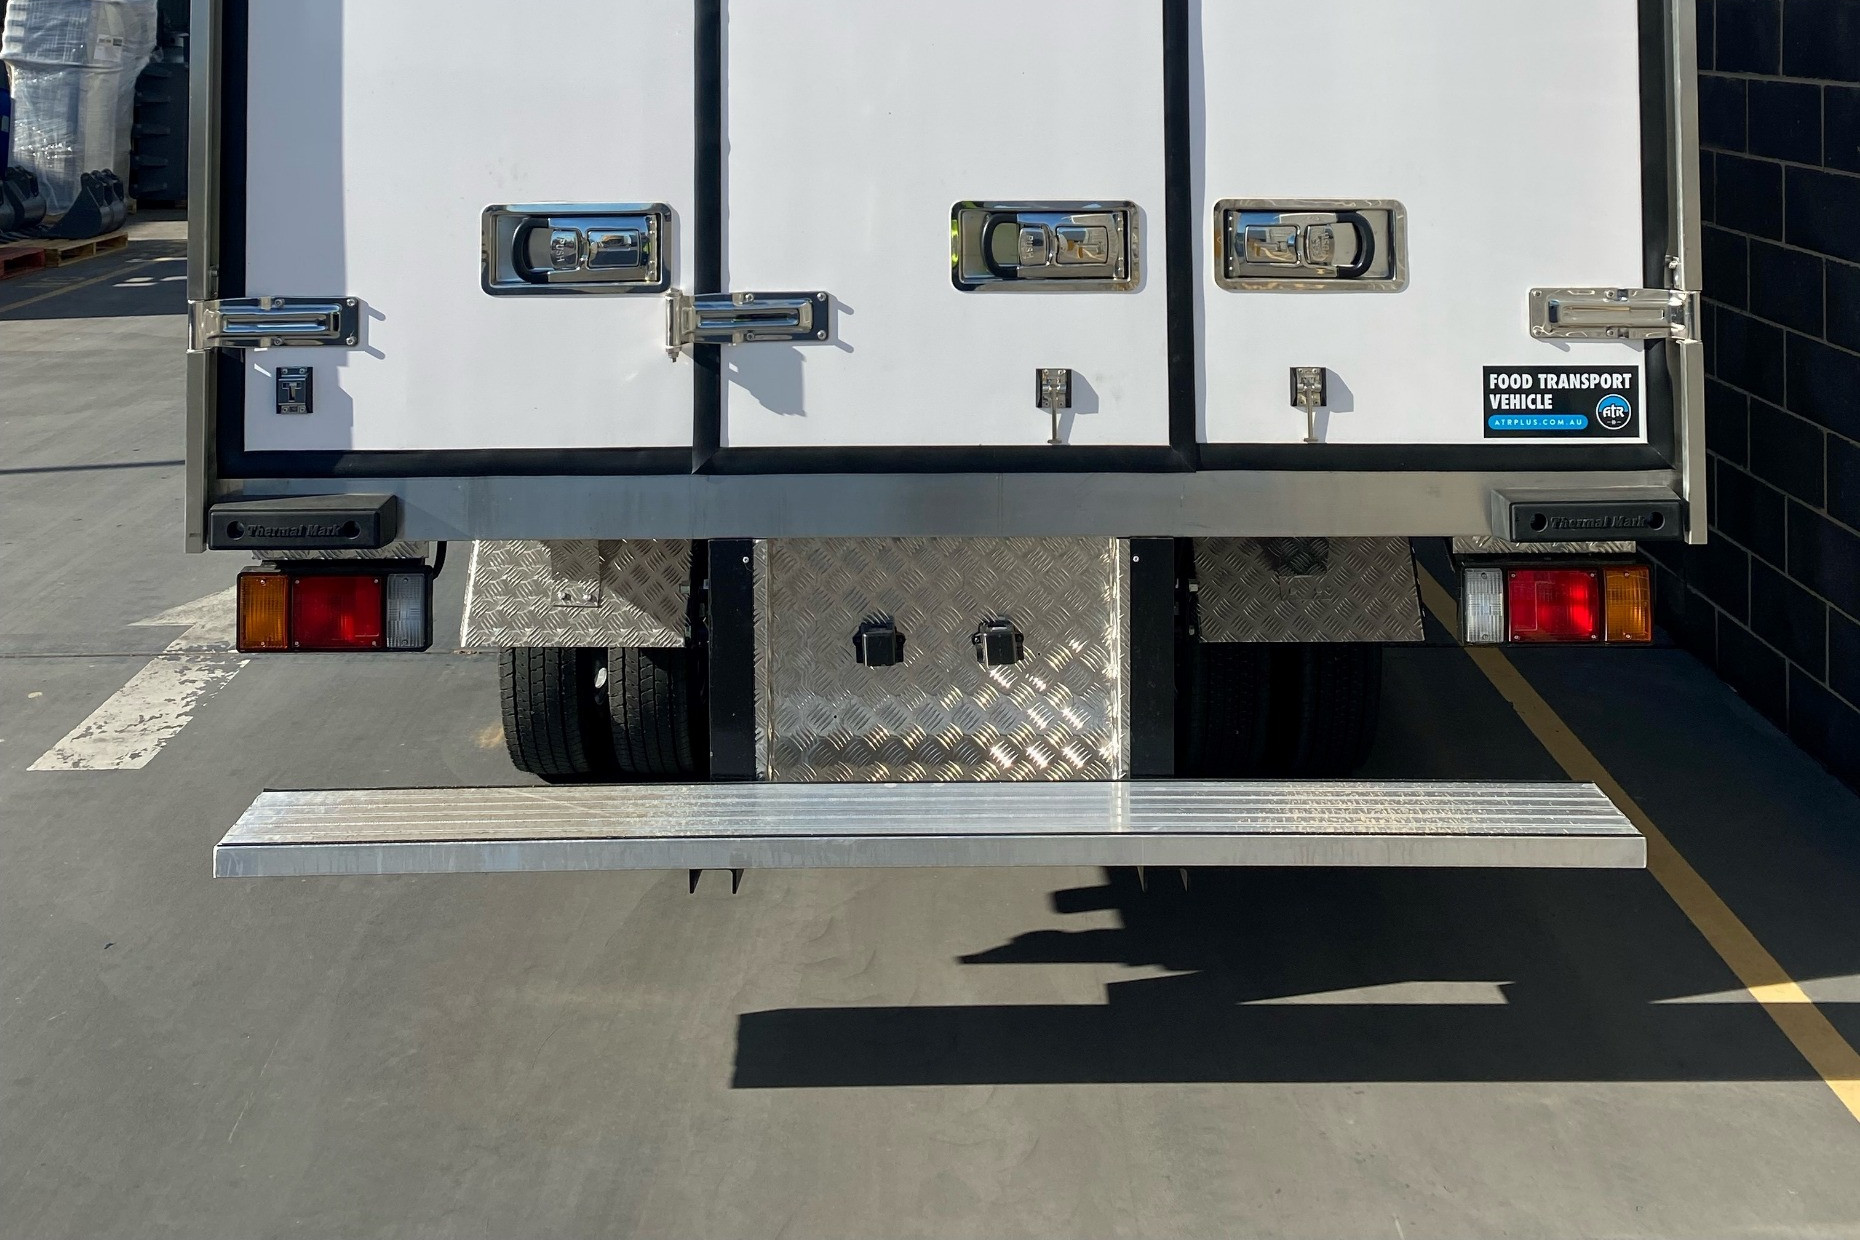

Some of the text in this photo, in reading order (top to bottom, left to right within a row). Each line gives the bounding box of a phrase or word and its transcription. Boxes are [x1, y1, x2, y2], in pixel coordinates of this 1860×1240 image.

[556, 237, 565, 262] PUSH
[1025, 235, 1034, 259] PUSH
[1489, 373, 1632, 389] FOOD TRANSPORT
[1489, 393, 1553, 410] VEHICLE
[1494, 419, 1583, 427] ATRPLUS.COM.AU
[1550, 515, 1647, 530] Thermal Mark
[247, 524, 343, 538] Thermal Mark
